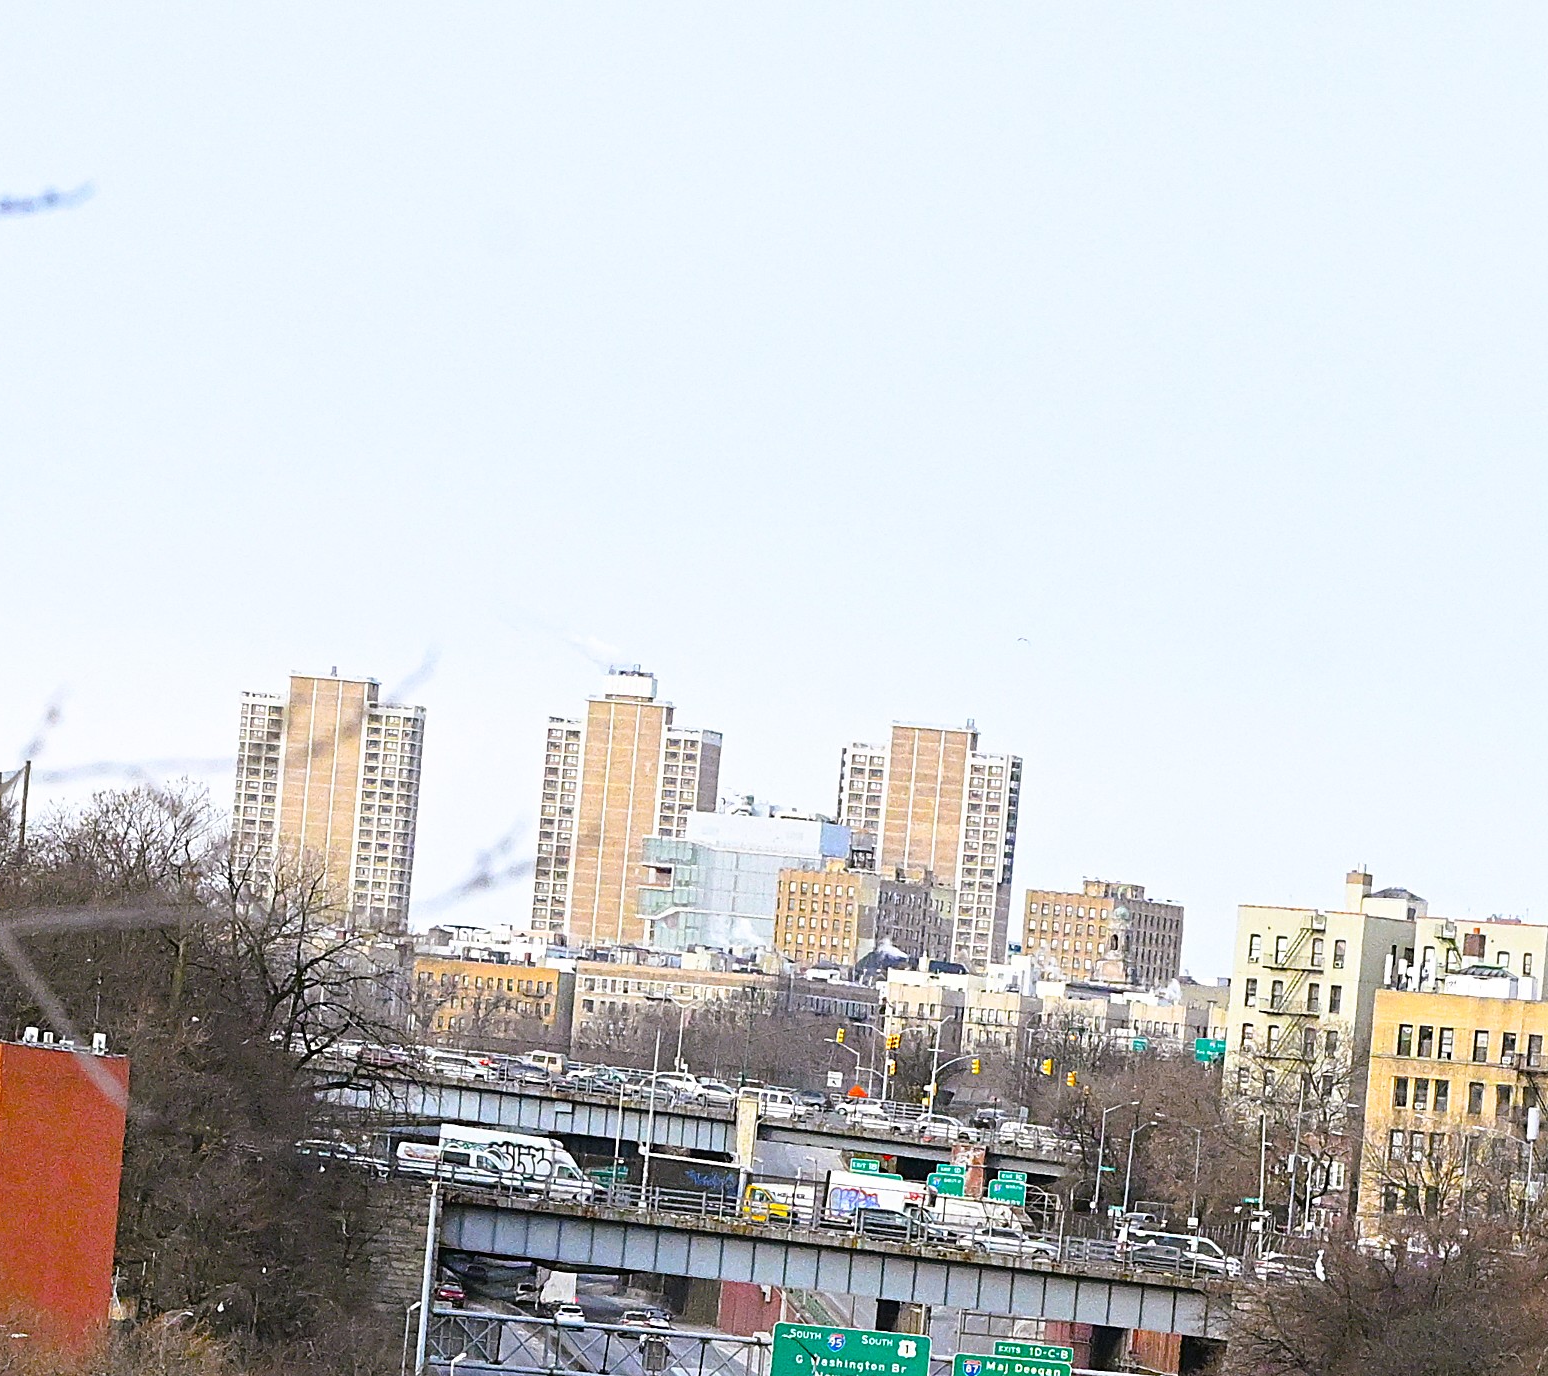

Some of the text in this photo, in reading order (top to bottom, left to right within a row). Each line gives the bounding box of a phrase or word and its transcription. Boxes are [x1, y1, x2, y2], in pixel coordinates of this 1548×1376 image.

[790, 1328, 822, 1340] SOUTH
[829, 1337, 843, 1348] 95
[861, 1334, 893, 1347] SOUTH
[998, 1345, 1069, 1359] EXITS 1D-C-B
[795, 1355, 804, 1364] G
[891, 1363, 908, 1374] Br
[965, 1365, 979, 1373] 87
[986, 1361, 1009, 1374] Maj
